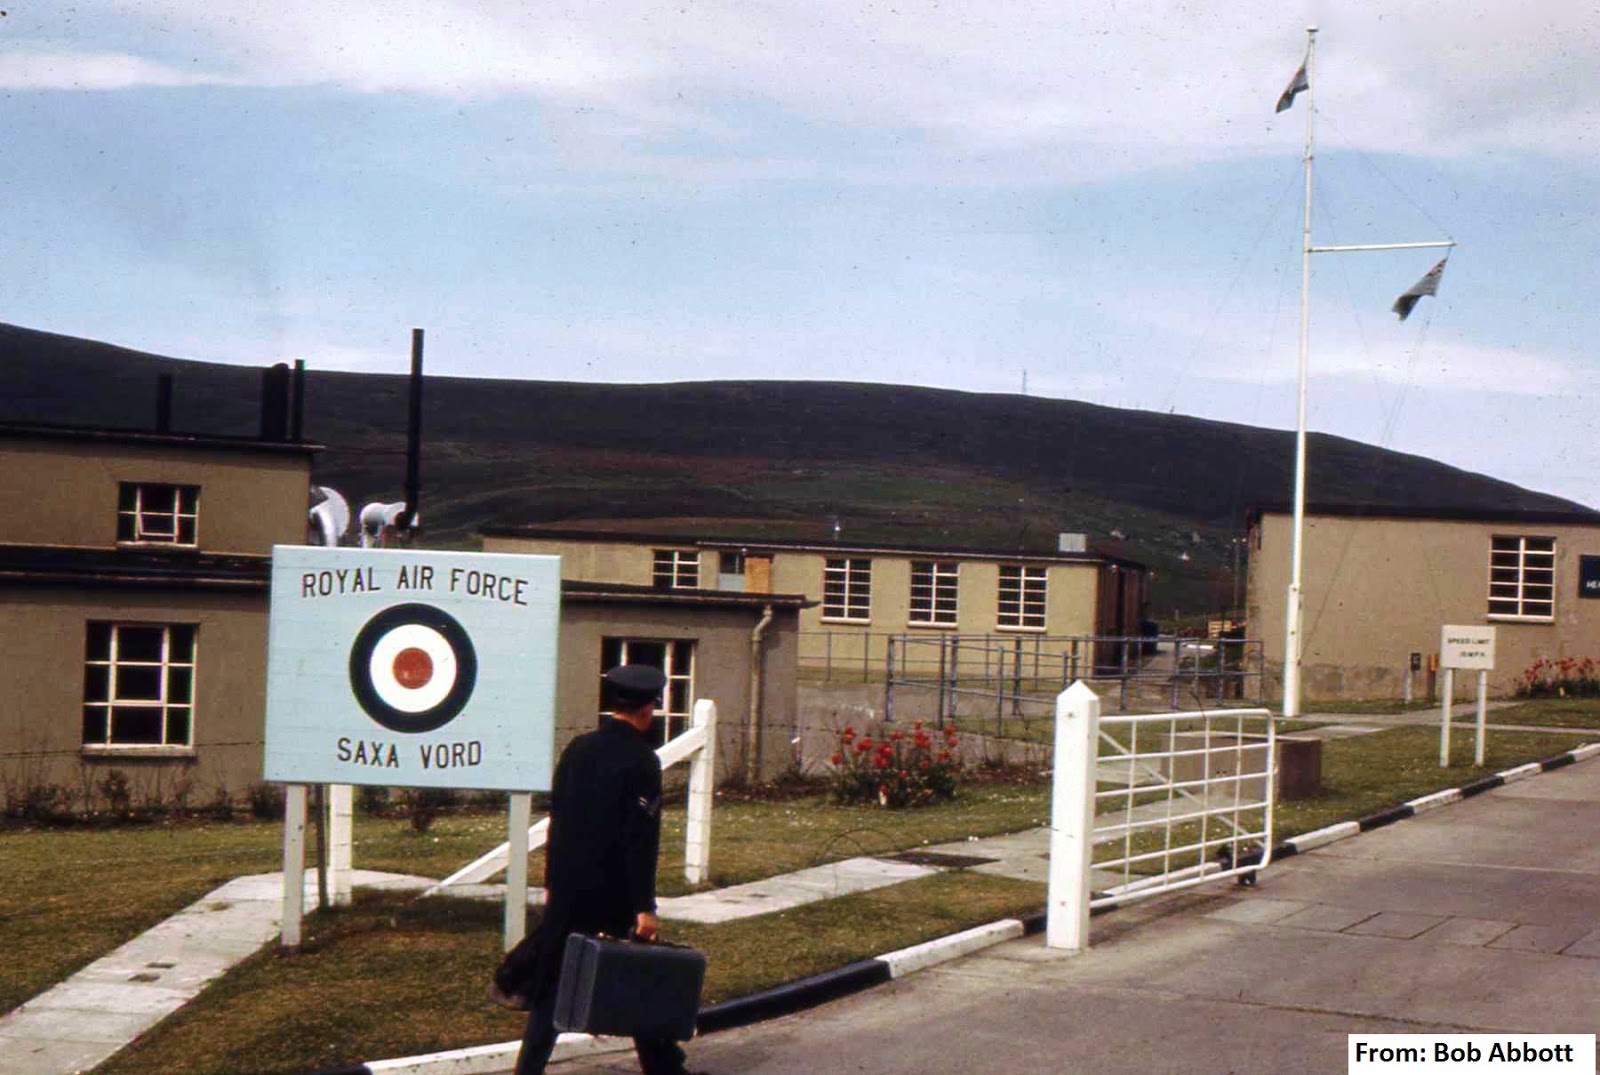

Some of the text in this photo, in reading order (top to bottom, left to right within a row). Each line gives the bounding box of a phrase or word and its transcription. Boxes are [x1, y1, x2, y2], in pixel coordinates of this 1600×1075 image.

[302, 565, 529, 606] ROYAL AIR FORCE
[337, 737, 482, 769] SAXA VORD
